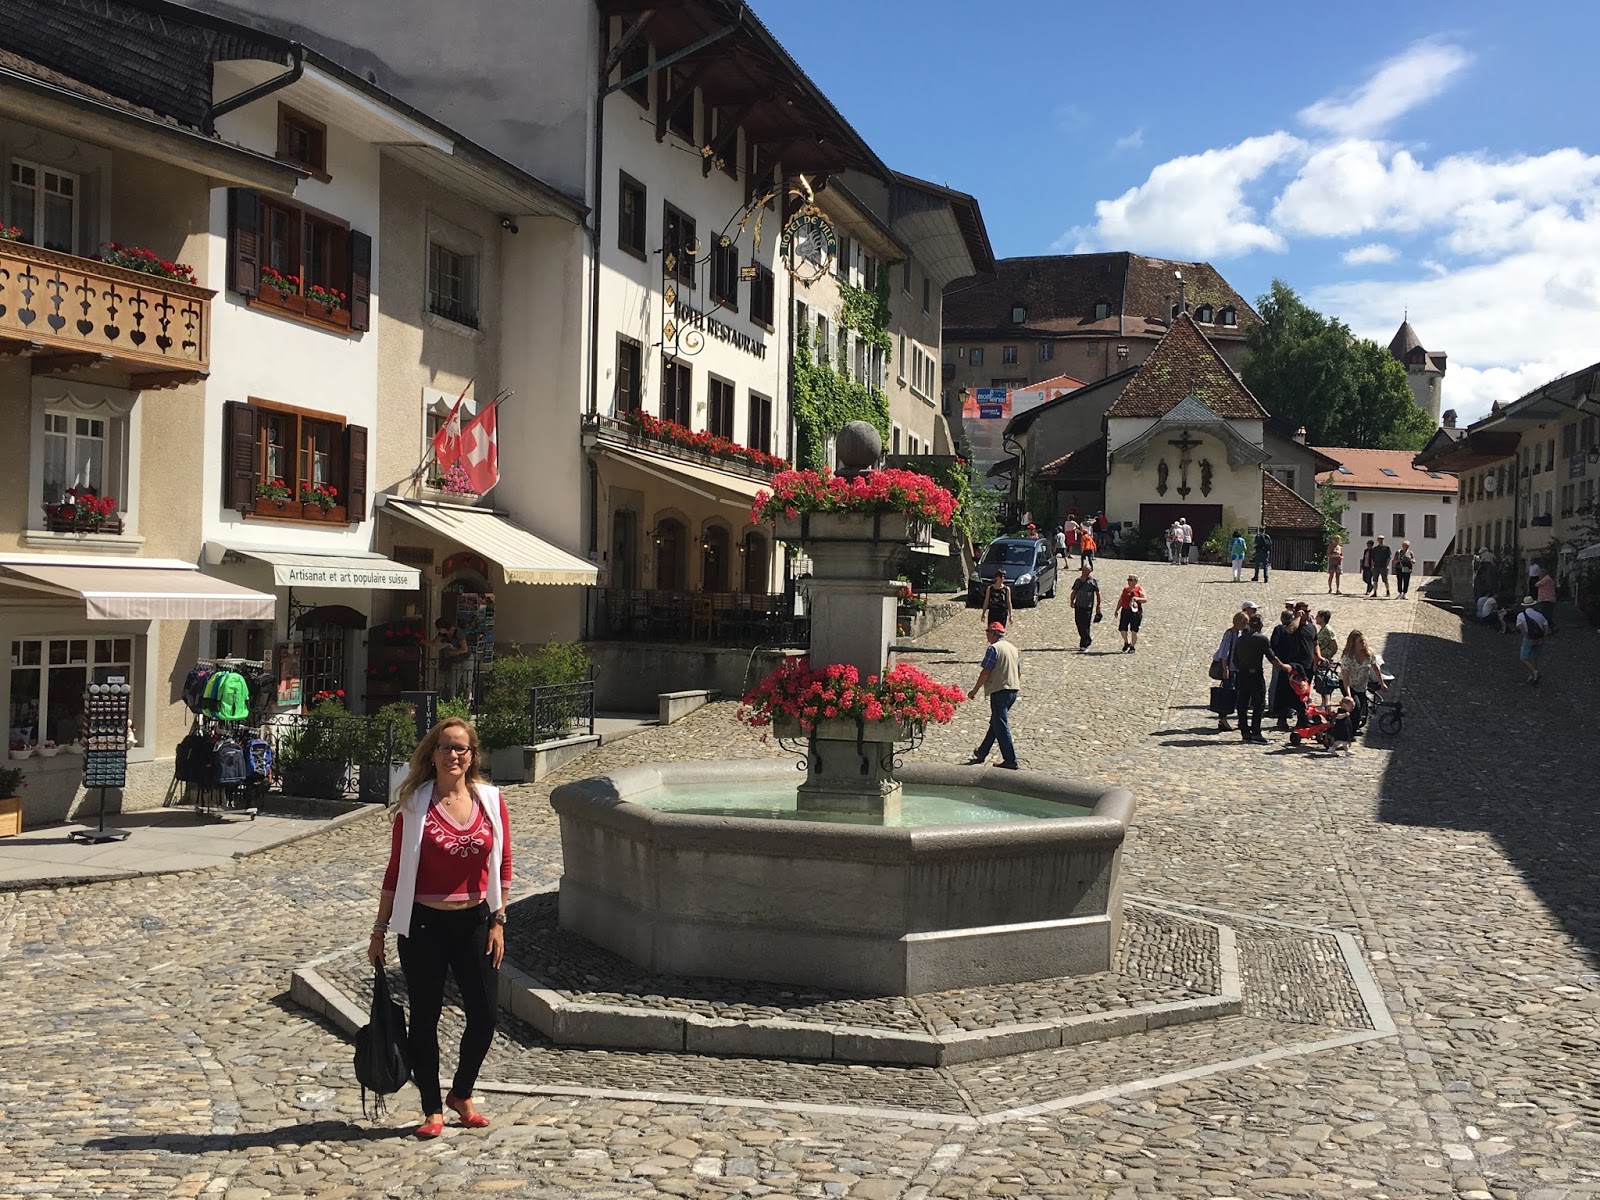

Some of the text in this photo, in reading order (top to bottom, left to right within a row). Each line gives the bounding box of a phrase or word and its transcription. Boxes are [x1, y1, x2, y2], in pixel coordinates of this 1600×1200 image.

[780, 216, 836, 248] HOTEL DE VILLE
[674, 300, 767, 361] HOTEL RESTAURANT
[289, 569, 408, 586] Artisanat et art populaire suisse
